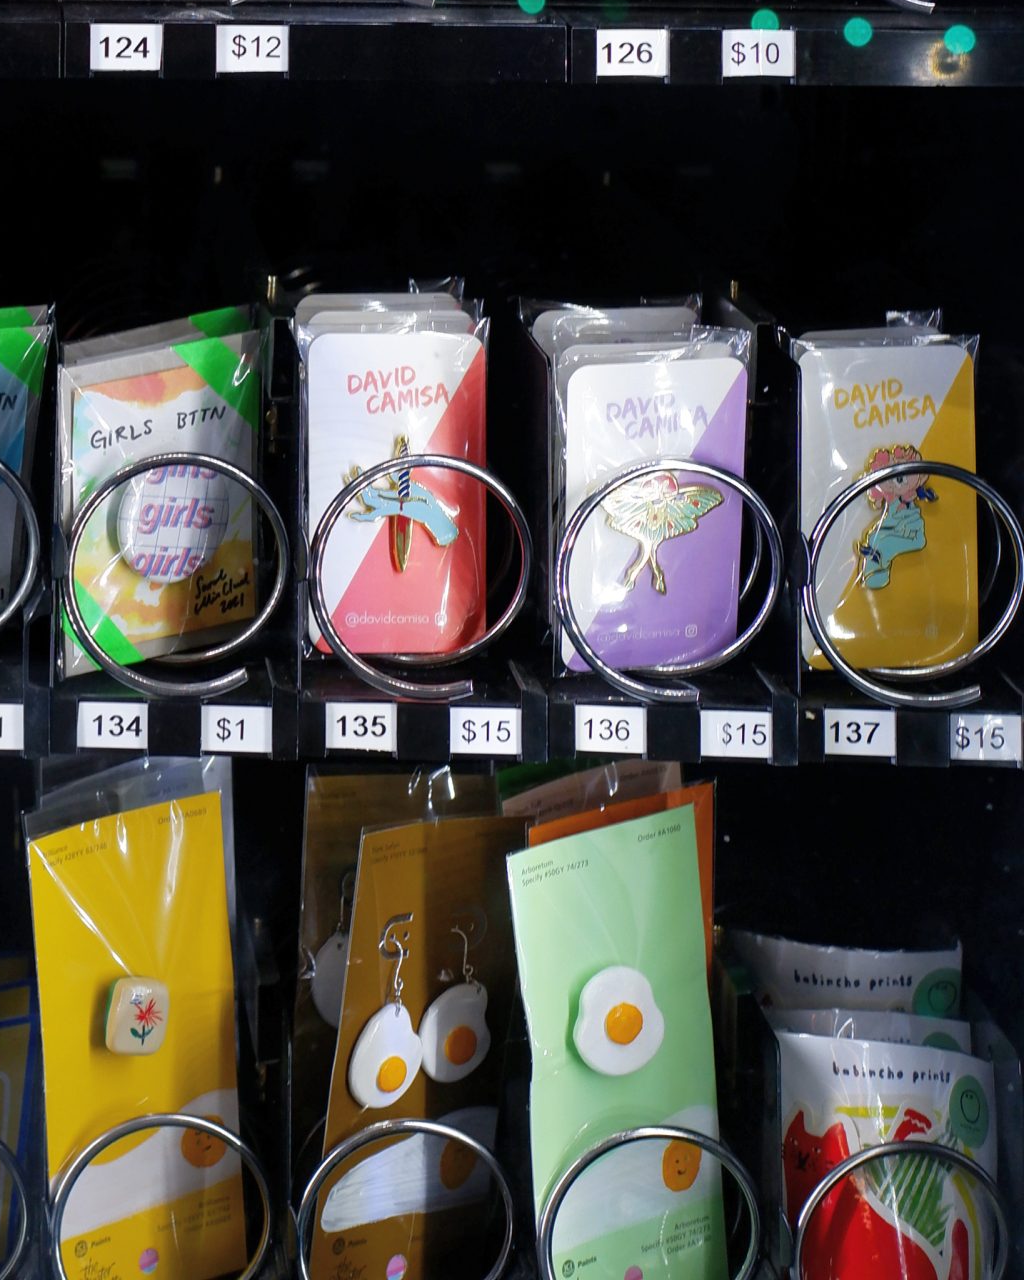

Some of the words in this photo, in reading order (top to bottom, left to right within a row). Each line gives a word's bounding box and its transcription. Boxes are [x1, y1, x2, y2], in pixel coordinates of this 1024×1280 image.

[100, 37, 149, 58] 124
[232, 35, 280, 58] $12
[603, 43, 652, 63] 126
[732, 42, 779, 65] $10
[347, 366, 416, 396] DAVID
[366, 383, 451, 415] CAMISA
[834, 378, 903, 410] DAVID
[625, 404, 709, 439] CAMIA
[853, 394, 938, 430] CAMISA
[90, 419, 154, 451] GIRLS
[176, 405, 227, 430] BTTN
[137, 496, 215, 535] girls
[345, 610, 430, 628] @davidcamisa
[93, 715, 142, 736] 134
[217, 718, 244, 741] $1
[337, 716, 386, 736] 135
[462, 720, 511, 743] $15
[585, 719, 629, 740] 136
[722, 723, 767, 746] $15
[831, 722, 880, 744] 137
[956, 727, 1004, 750] $15
[637, 832, 656, 842] Order
[521, 860, 554, 876] Arboretum
[521, 873, 543, 888] Specify
[869, 975, 913, 991] prints
[913, 1069, 951, 1084] prints
